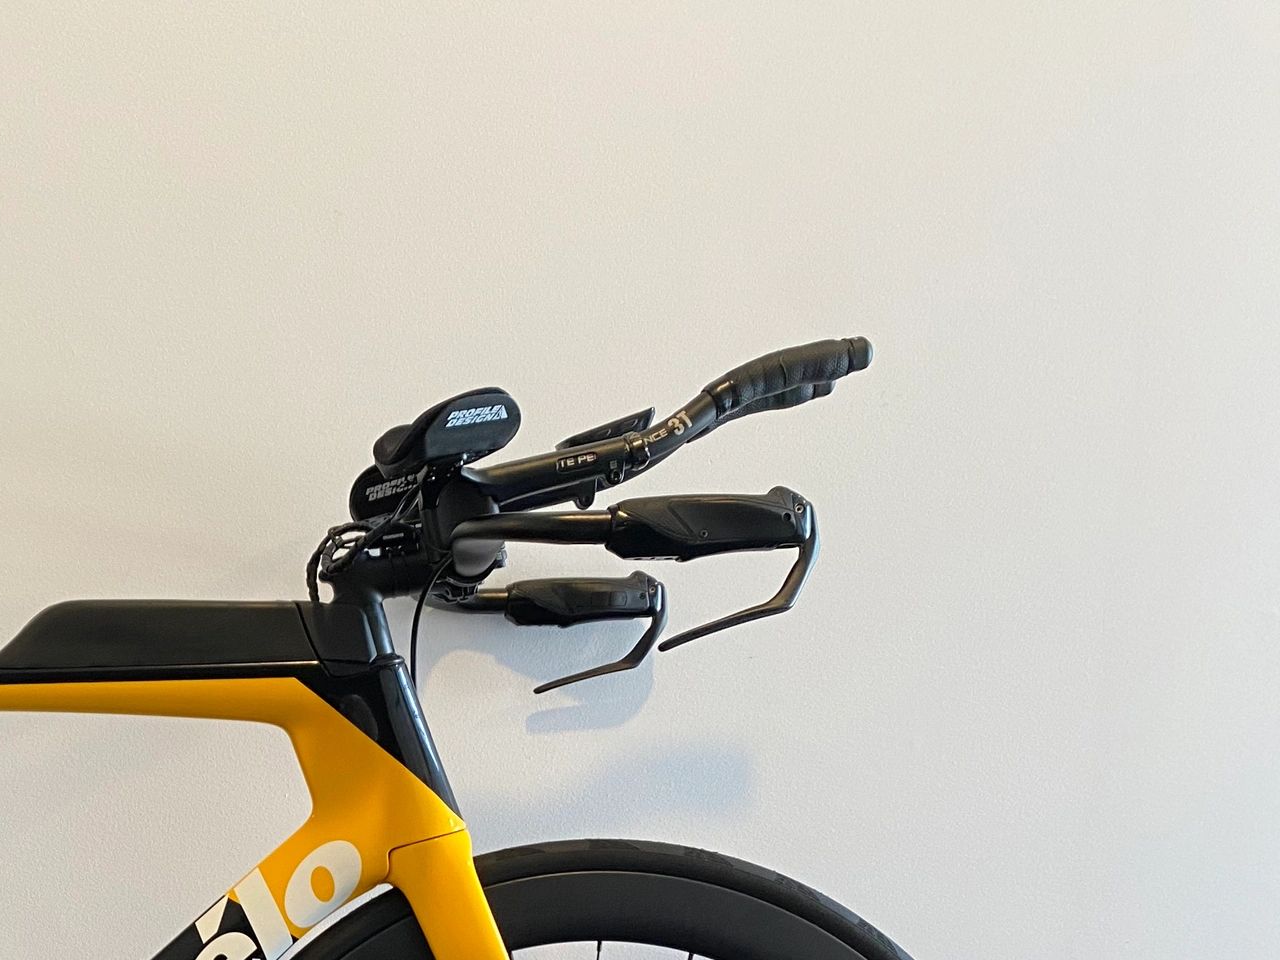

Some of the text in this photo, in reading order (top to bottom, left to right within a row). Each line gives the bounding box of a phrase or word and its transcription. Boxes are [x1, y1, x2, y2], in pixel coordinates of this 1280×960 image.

[447, 404, 502, 420] PROFILE
[445, 413, 496, 428] DESIGN
[667, 410, 693, 436] 3T
